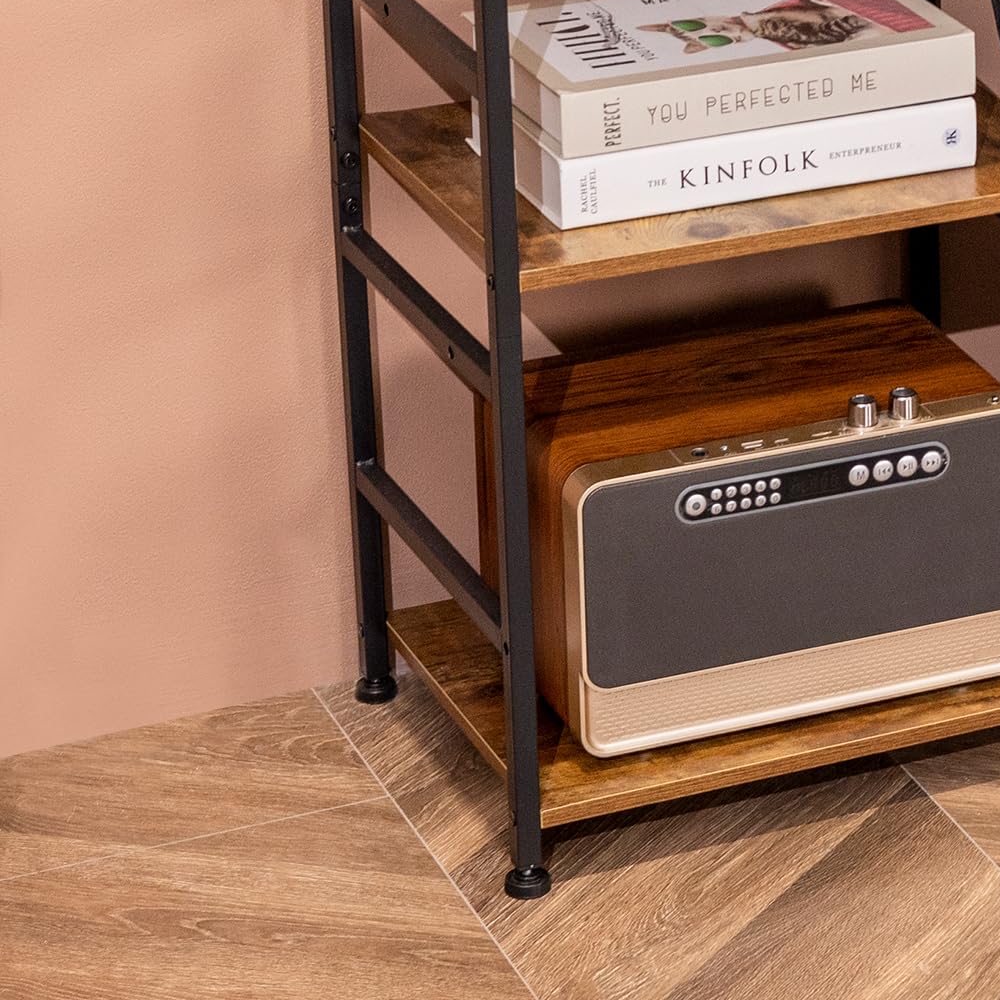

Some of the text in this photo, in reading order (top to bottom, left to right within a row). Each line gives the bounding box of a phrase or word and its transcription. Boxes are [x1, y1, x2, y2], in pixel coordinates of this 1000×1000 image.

[647, 69, 878, 126] YOU PERFECTED ME
[603, 97, 622, 148] PERFECT.
[647, 142, 903, 189] THE KINFOLK ENTERPRENEUR
[580, 175, 589, 214] RACHEL
